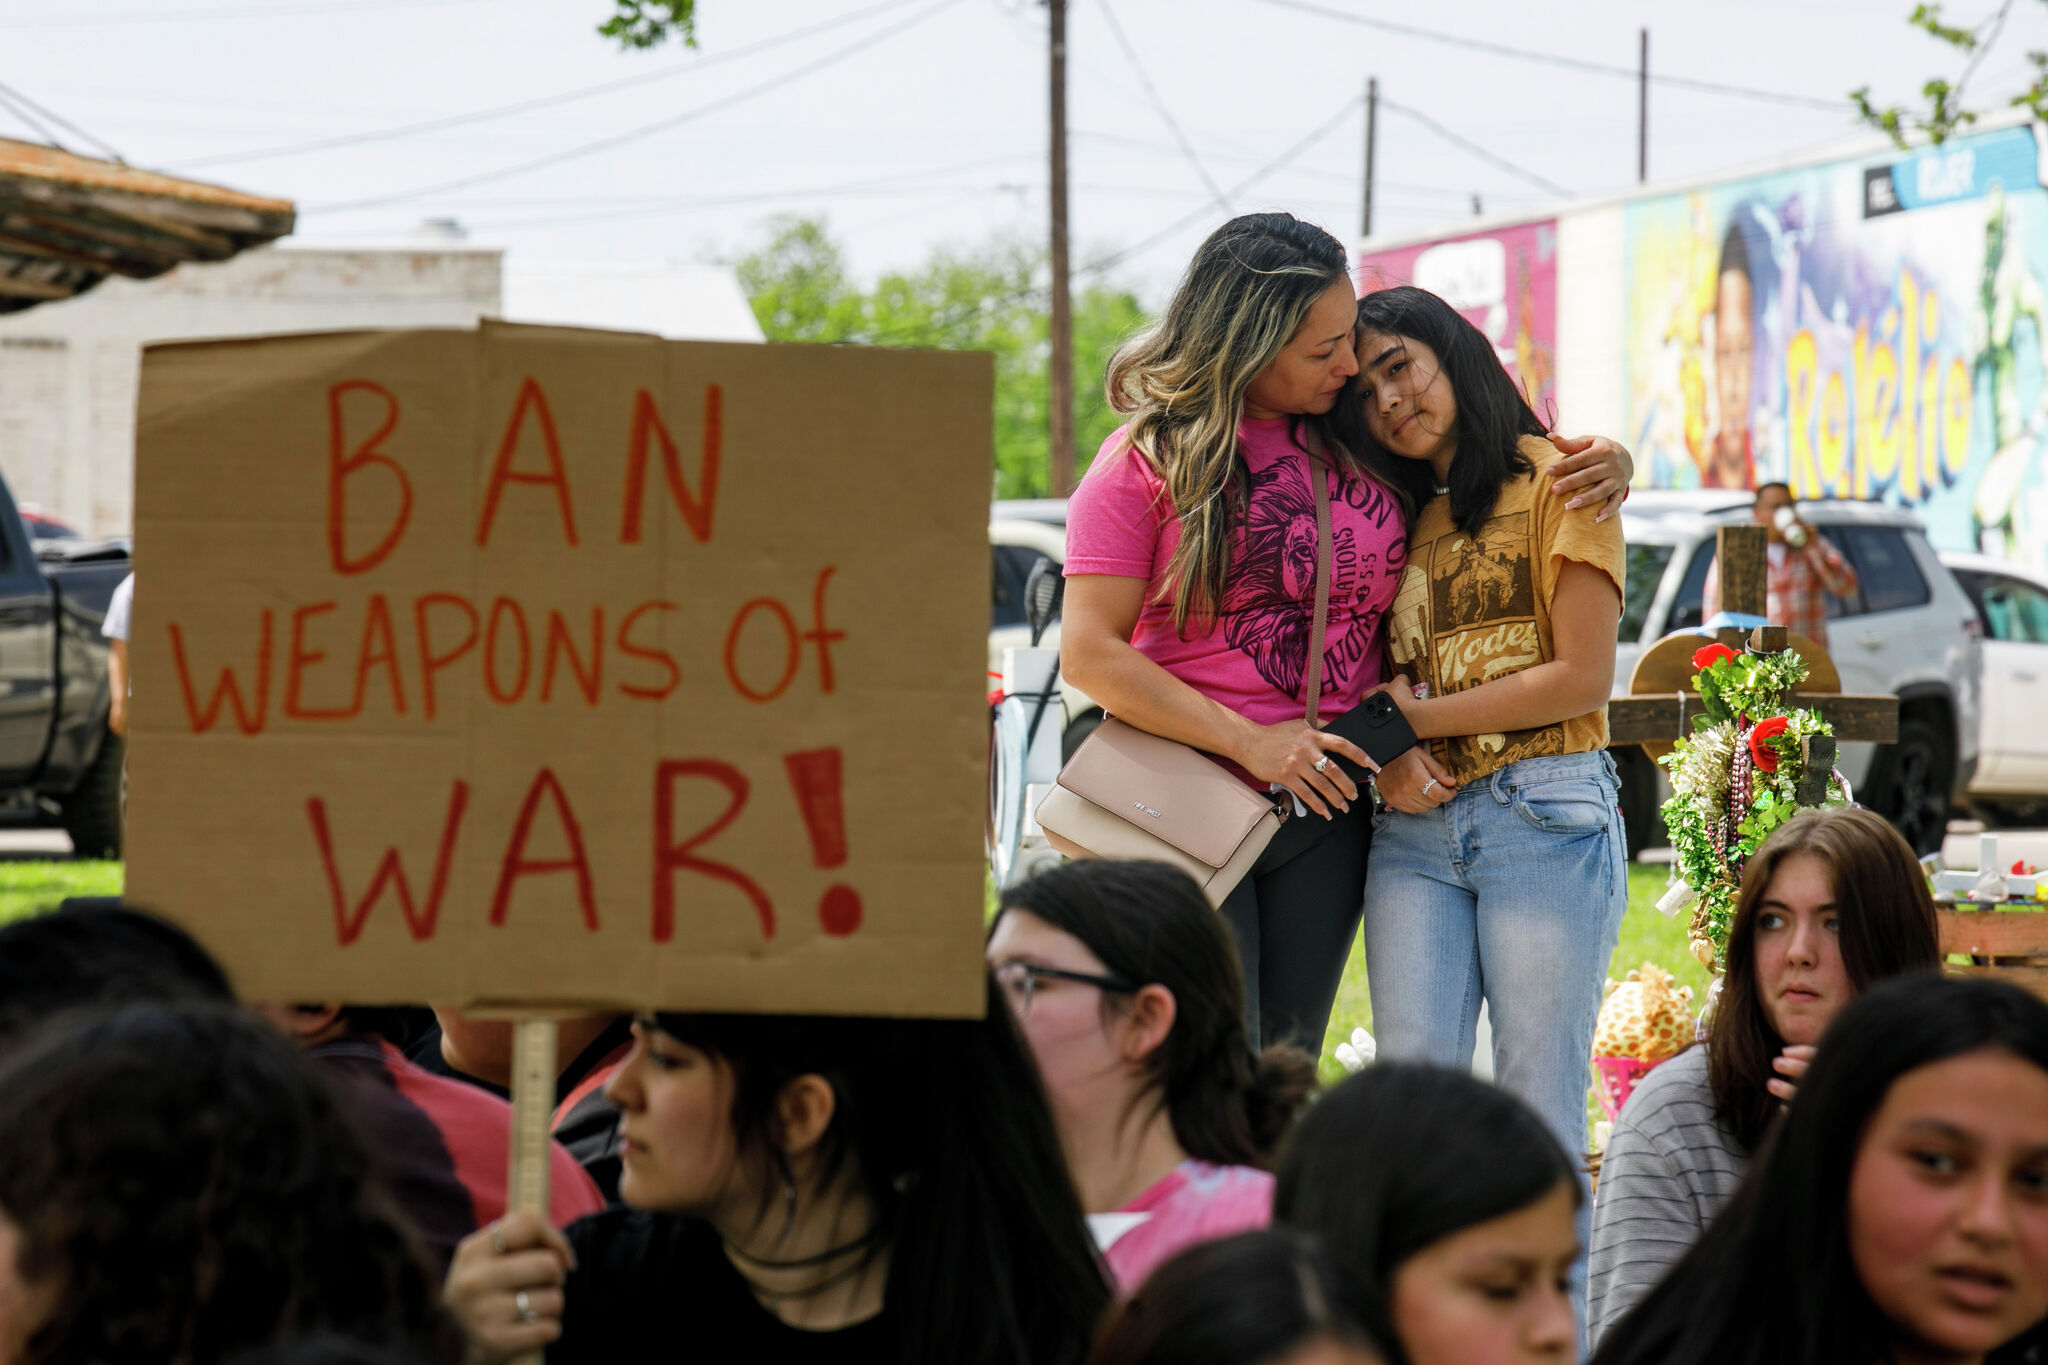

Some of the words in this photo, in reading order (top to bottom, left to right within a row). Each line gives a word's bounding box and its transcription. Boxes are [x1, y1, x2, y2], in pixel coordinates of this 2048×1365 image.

[328, 376, 723, 577] BAN
[1360, 552, 1377, 580] 5:5
[168, 590, 682, 737] WEAPONS
[306, 747, 864, 948] WAR!
